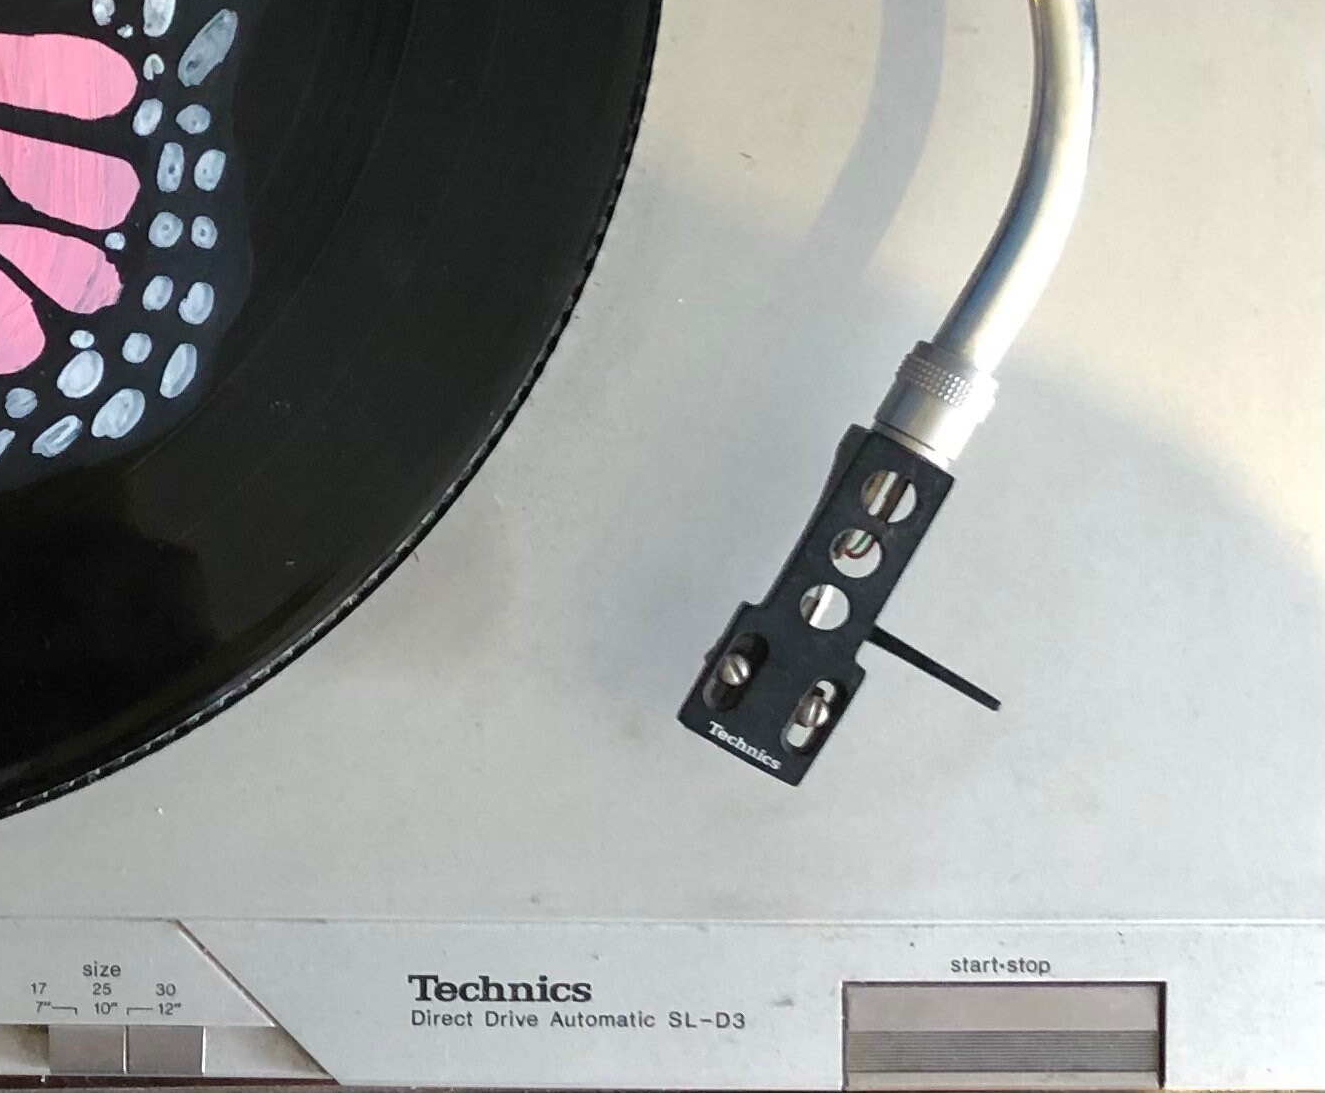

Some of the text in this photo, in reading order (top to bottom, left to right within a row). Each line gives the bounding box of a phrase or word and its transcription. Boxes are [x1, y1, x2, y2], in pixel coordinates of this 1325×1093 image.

[709, 721, 781, 769] Technics
[82, 961, 121, 977] size
[31, 982, 176, 996] 17 25 30
[407, 974, 592, 1003] Technics
[94, 1002, 118, 1015] 10"
[158, 1002, 181, 1016] 12"
[411, 1009, 746, 1030] Direct Drive Automatic SL-D3
